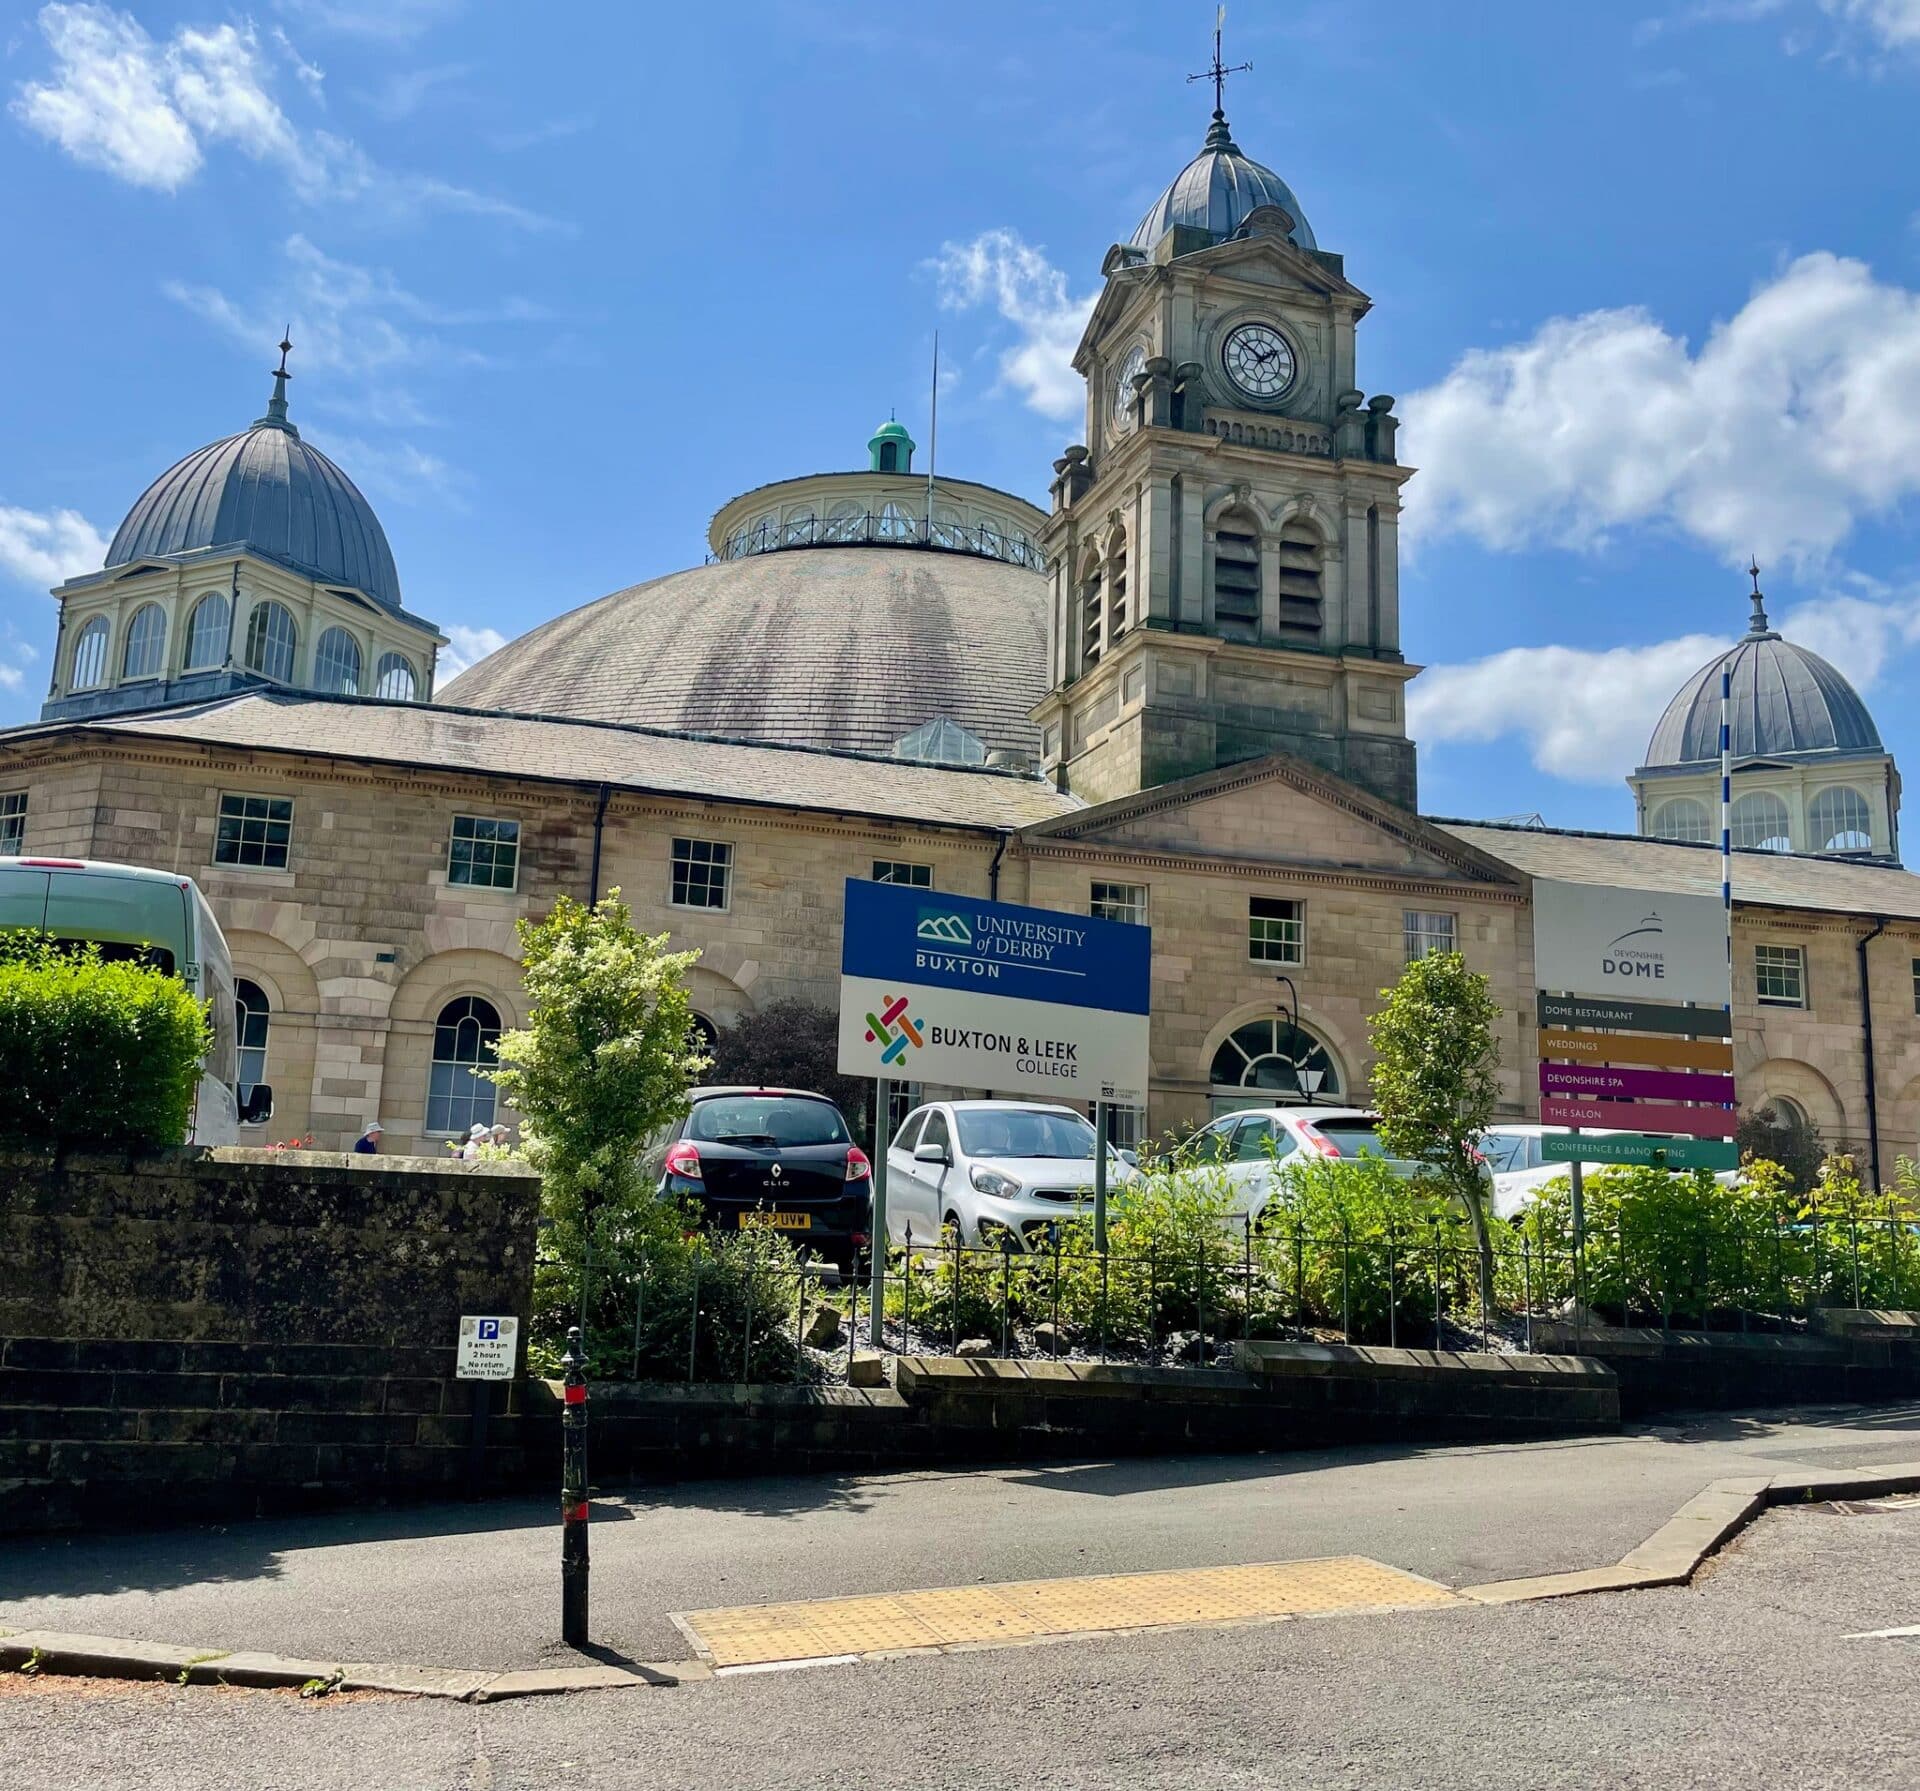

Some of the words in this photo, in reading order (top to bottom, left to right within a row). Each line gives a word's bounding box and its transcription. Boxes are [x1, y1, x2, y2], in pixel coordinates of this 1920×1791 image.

[976, 915, 1086, 947] UNIVERSITY
[976, 936, 991, 955] of
[995, 937, 1054, 961] DERBY
[1613, 949, 1665, 961] DEVONSHIRE
[916, 954, 1000, 978] BUXTON
[1602, 959, 1665, 979] DOME
[1545, 1005, 1573, 1016] DOME
[1575, 1008, 1633, 1021] RESTAURANT
[931, 1026, 1011, 1053] BUXTON
[1016, 1038, 1030, 1056] &
[1035, 1040, 1078, 1061] LEEK
[1547, 1039, 1599, 1051] WEDDINGS
[1016, 1058, 1078, 1079] COLLEGE
[1547, 1073, 1606, 1086] DEVONSHIRE
[1608, 1077, 1624, 1088] SPA
[1549, 1107, 1568, 1117] THE
[1570, 1108, 1601, 1119] SALON
[1550, 1142, 1612, 1154] CONFERENCE
[1615, 1146, 1621, 1155] &
[1623, 1146, 1686, 1159] BANQING
[782, 1213, 805, 1226] UVW
[483, 1321, 496, 1338] P
[496, 1342, 508, 1350] pm
[473, 1351, 478, 1359] 2
[480, 1351, 501, 1359] hours
